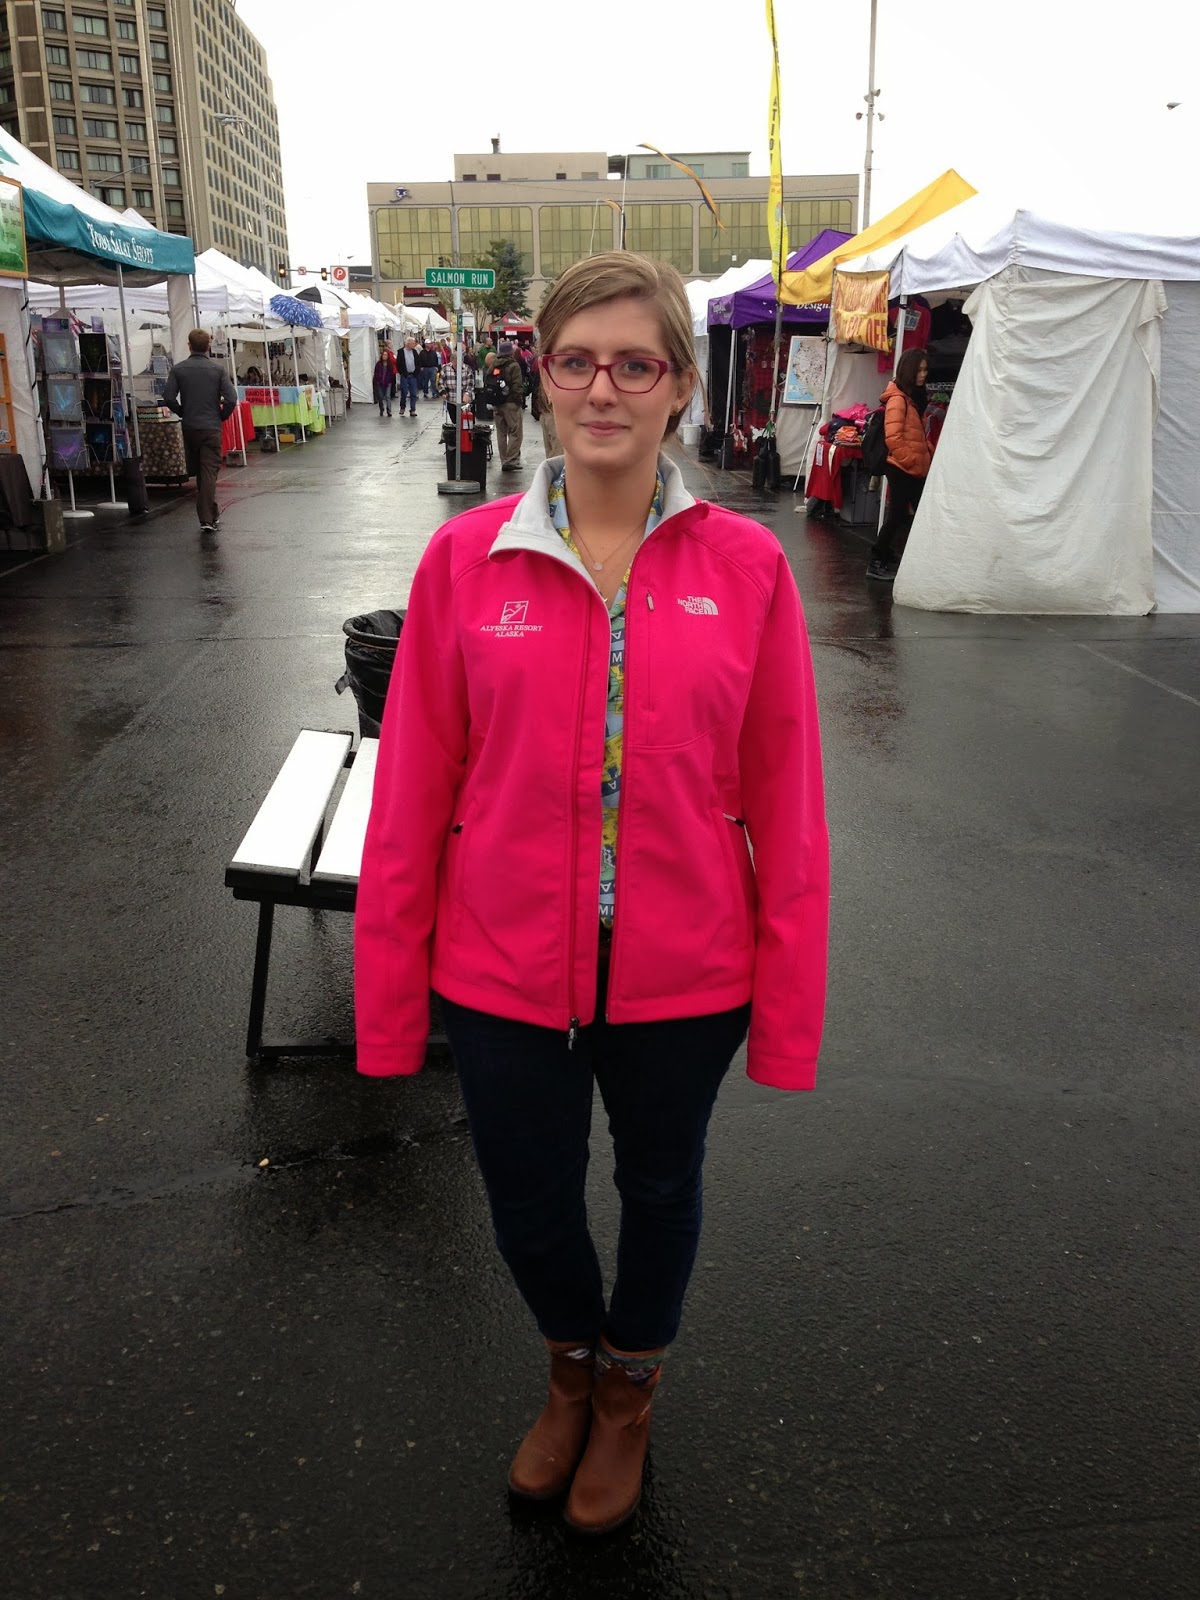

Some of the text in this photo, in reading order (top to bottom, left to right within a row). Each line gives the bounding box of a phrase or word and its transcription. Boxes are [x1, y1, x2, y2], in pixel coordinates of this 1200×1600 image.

[430, 271, 489, 285] SALMON RUN
[677, 598, 703, 609] NORTH
[687, 595, 703, 603] THE
[685, 605, 704, 615] FACE
